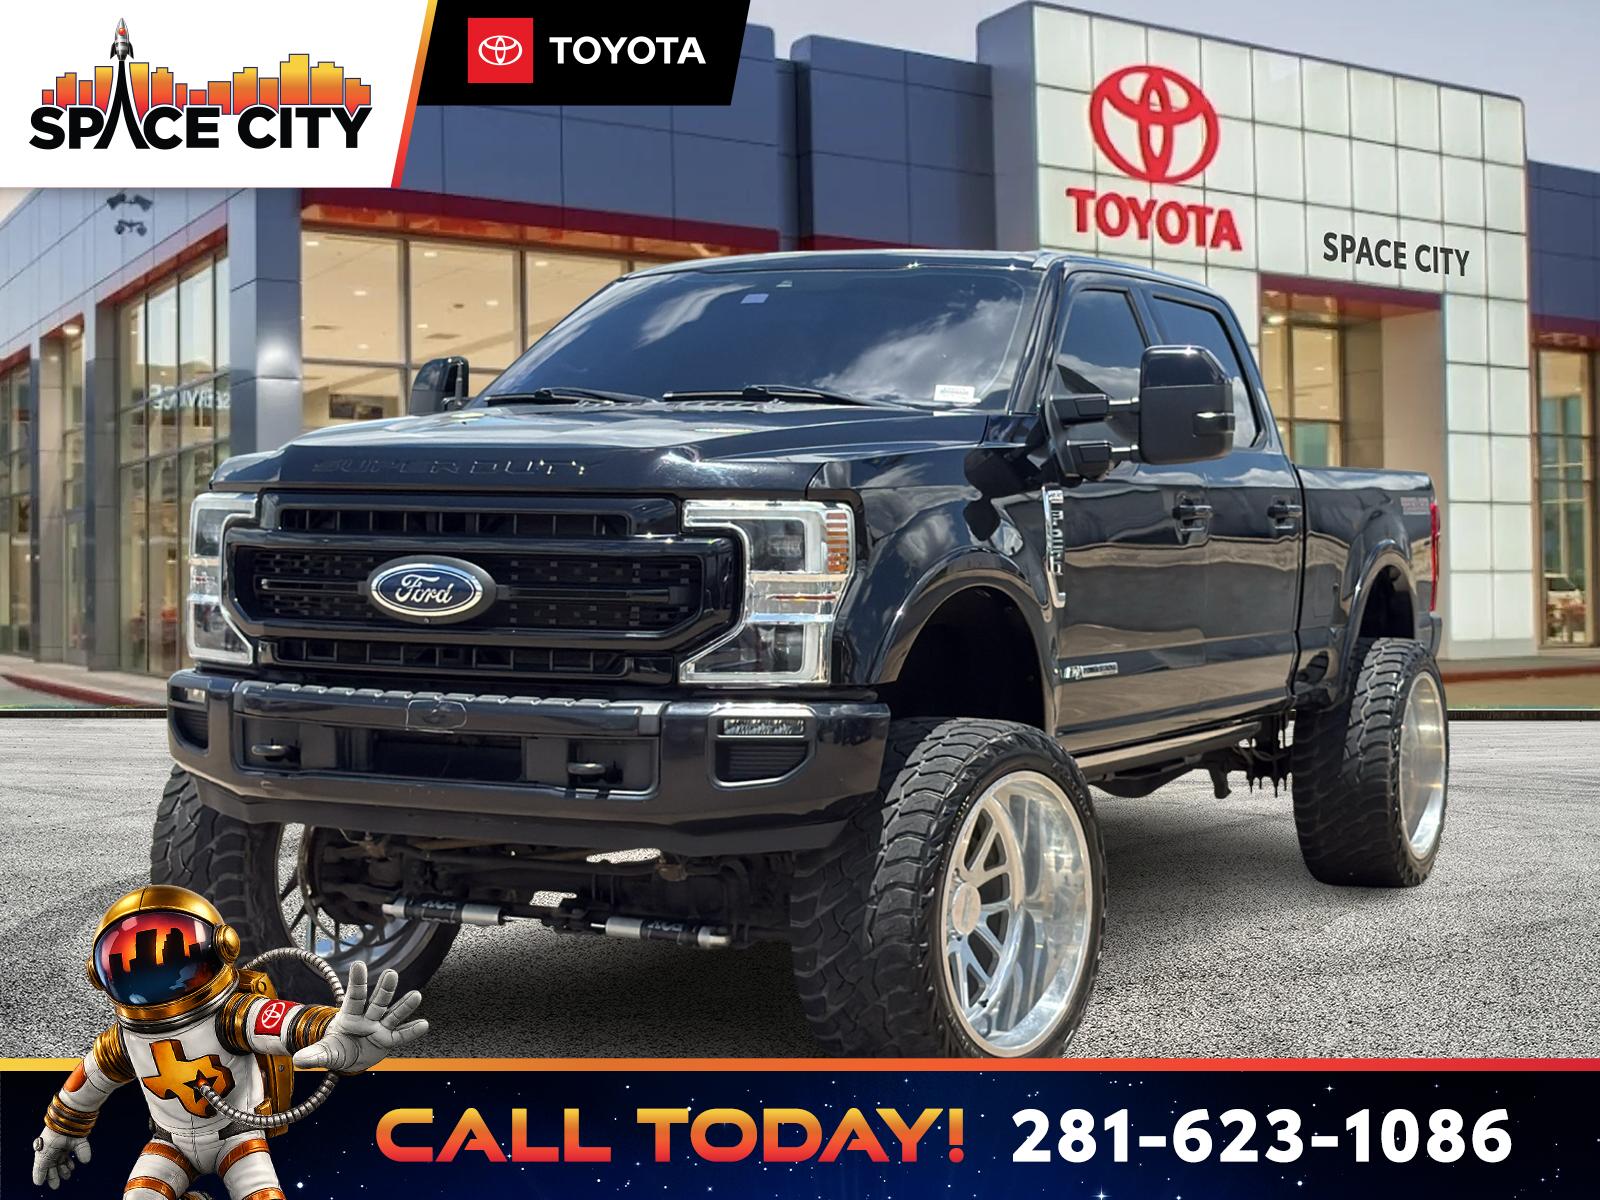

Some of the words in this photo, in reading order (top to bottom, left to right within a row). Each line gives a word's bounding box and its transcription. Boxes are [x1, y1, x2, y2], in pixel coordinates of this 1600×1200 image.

[1066, 188, 1242, 251] TOYOTA
[1323, 231, 1406, 270] SPACE
[1414, 244, 1470, 277] CITY
[395, 573, 454, 604] Ford
